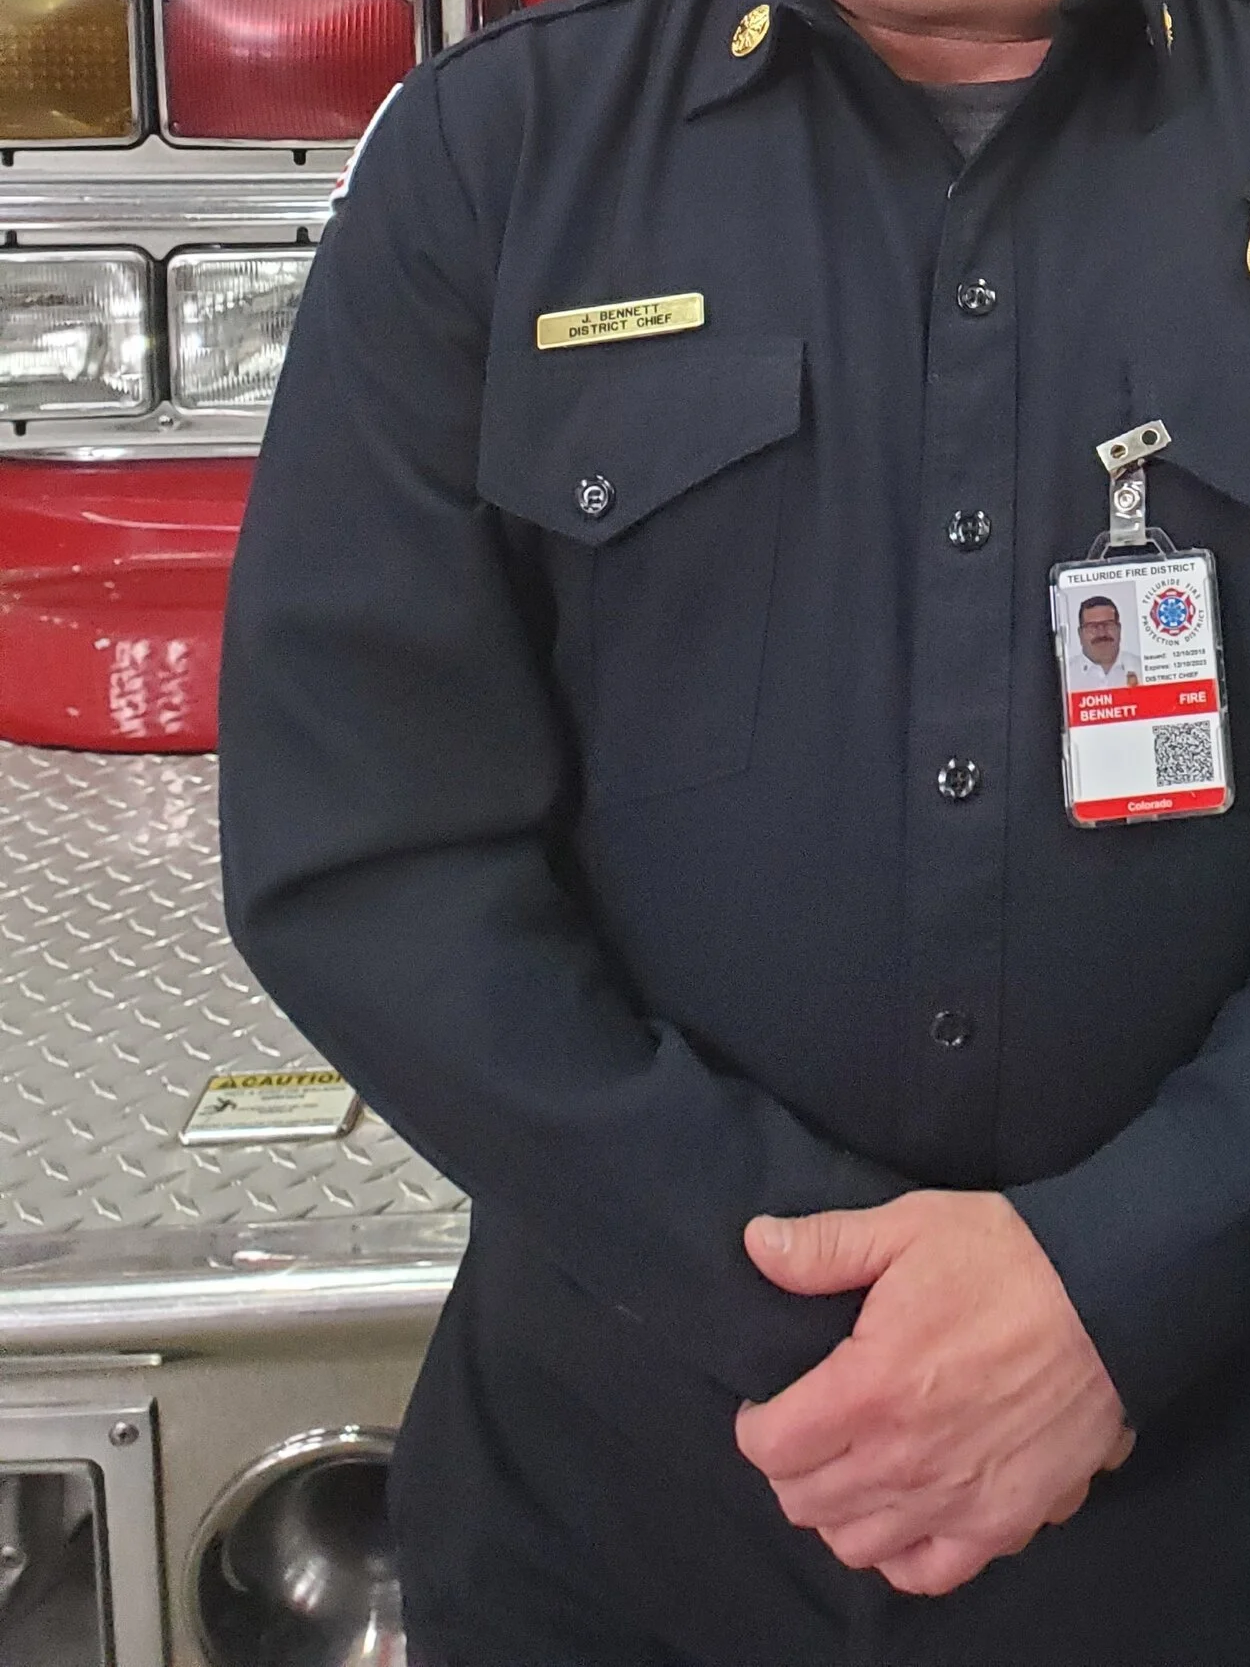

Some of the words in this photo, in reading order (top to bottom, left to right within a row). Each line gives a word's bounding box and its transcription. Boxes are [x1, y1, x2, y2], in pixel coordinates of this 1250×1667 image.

[581, 314, 592, 324] J.
[600, 303, 660, 322] BENNETT
[569, 319, 629, 338] DISTRICT
[637, 313, 672, 328] CHIEF
[1068, 570, 1122, 584] TELLURIDE
[1126, 567, 1149, 578] FIRE
[1151, 563, 1196, 575] DISTRICT
[1142, 578, 1181, 604] TELLURIDE
[1185, 583, 1201, 600] FIRE
[1142, 615, 1180, 646] PROTECTION
[1185, 609, 1205, 643] DISTRICT
[1145, 673, 1177, 682] DISTRICT
[1178, 671, 1199, 679] CHIEF
[1078, 694, 1112, 708] JOHN
[1179, 691, 1207, 705] FIRE
[1080, 705, 1137, 722] BENNETT
[1127, 798, 1173, 812] Colorado
